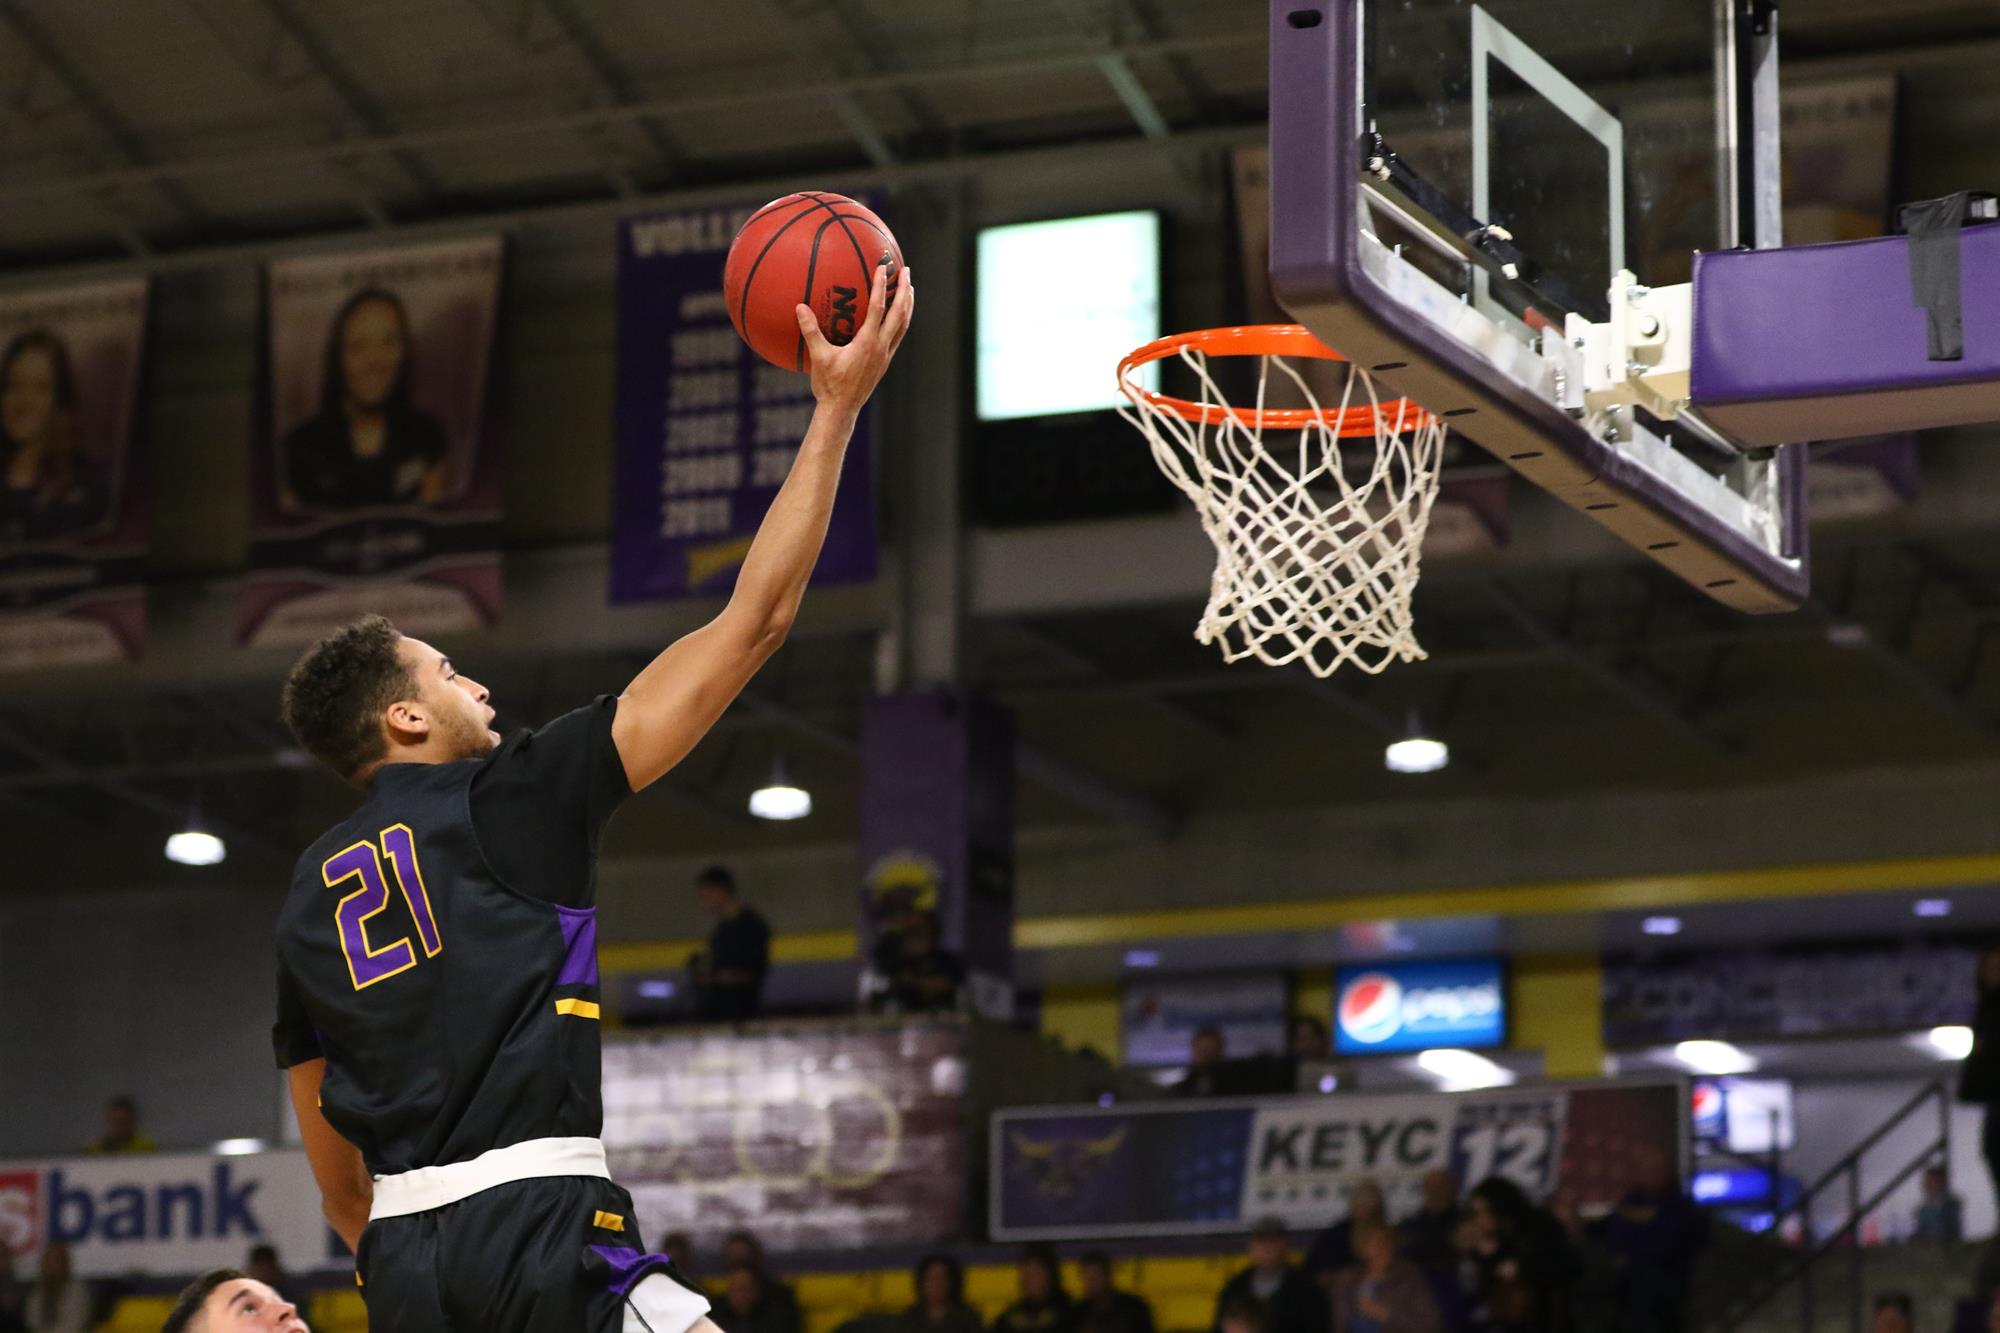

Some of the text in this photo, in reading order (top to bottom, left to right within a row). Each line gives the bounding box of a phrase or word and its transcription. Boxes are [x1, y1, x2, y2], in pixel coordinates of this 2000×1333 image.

[322, 823, 442, 991] 21
[1402, 981, 1501, 1025] pepsi
[1259, 1117, 1439, 1172] KEYC
[1461, 1126, 1548, 1192] 12
[49, 1164, 259, 1242] bank
